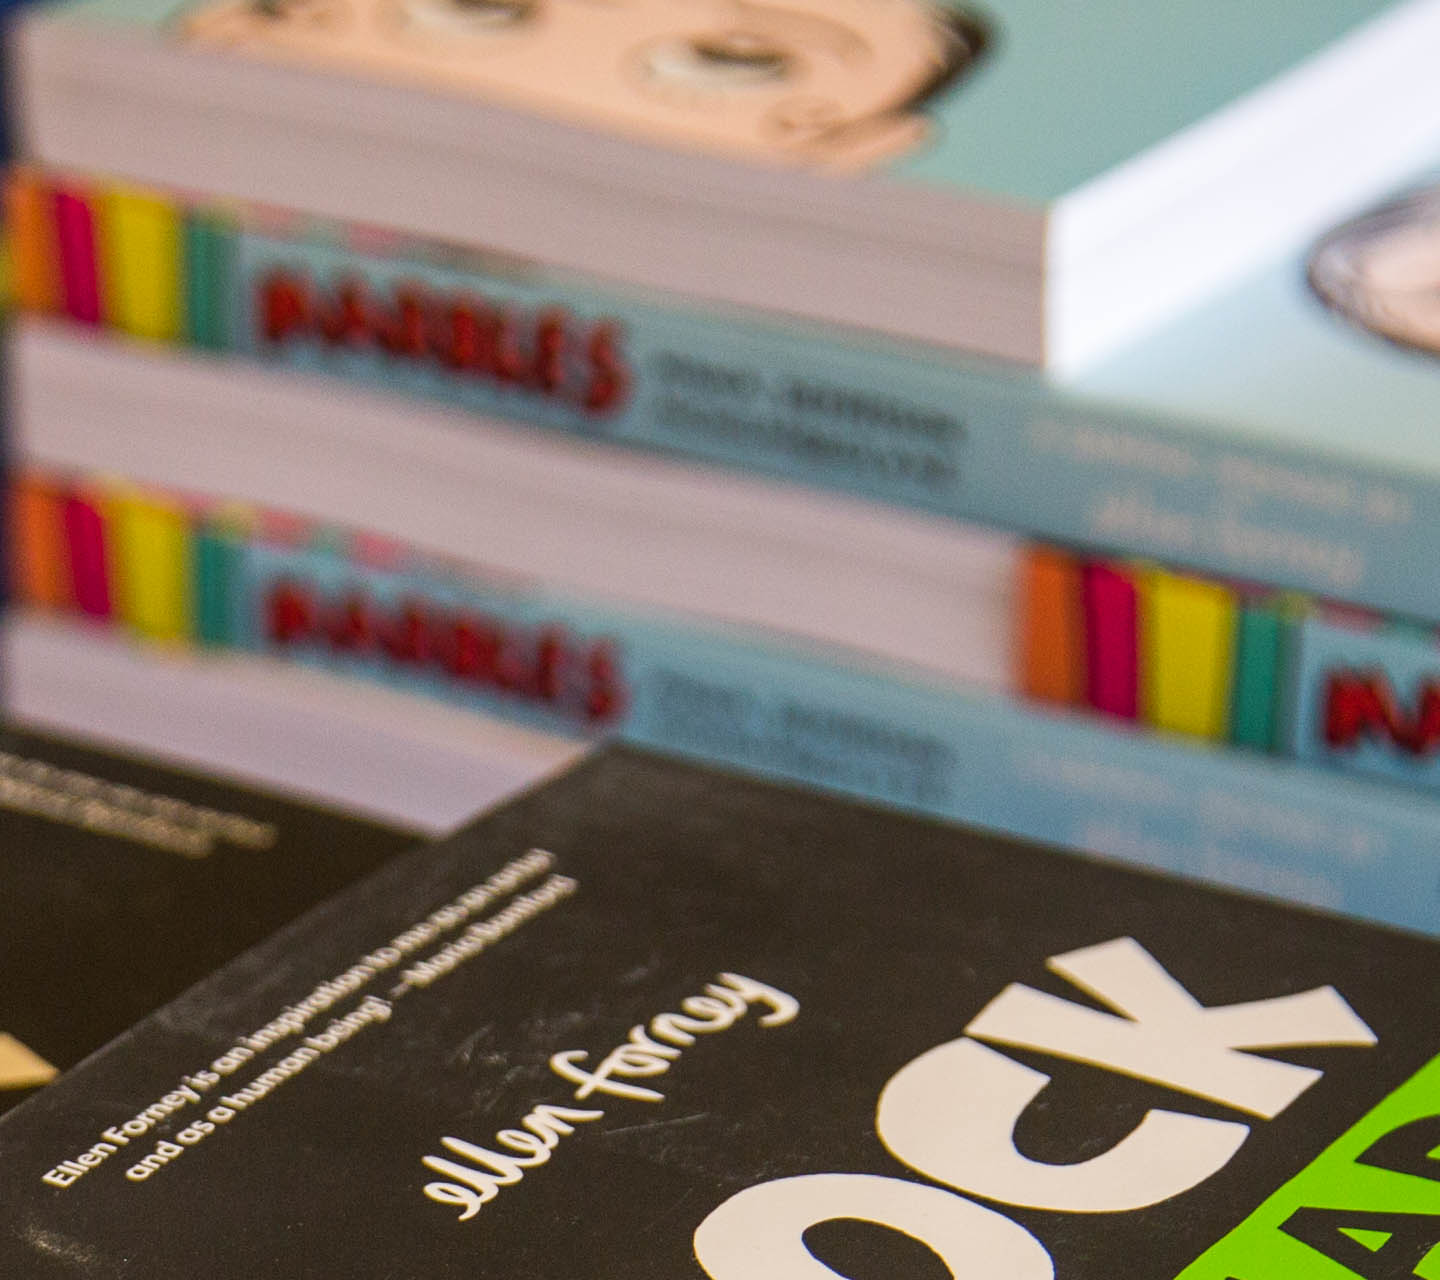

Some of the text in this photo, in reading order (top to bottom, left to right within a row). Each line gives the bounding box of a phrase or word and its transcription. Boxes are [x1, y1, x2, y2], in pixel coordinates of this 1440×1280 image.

[220, 1047, 321, 1113] human
[423, 972, 800, 1220] ellen forney
[42, 1142, 116, 1188] Ellen
[103, 1087, 201, 1144] Forney
[213, 1045, 255, 1076] an
[180, 1118, 215, 1146] as
[208, 1103, 236, 1125] a
[125, 1138, 184, 1181] and
